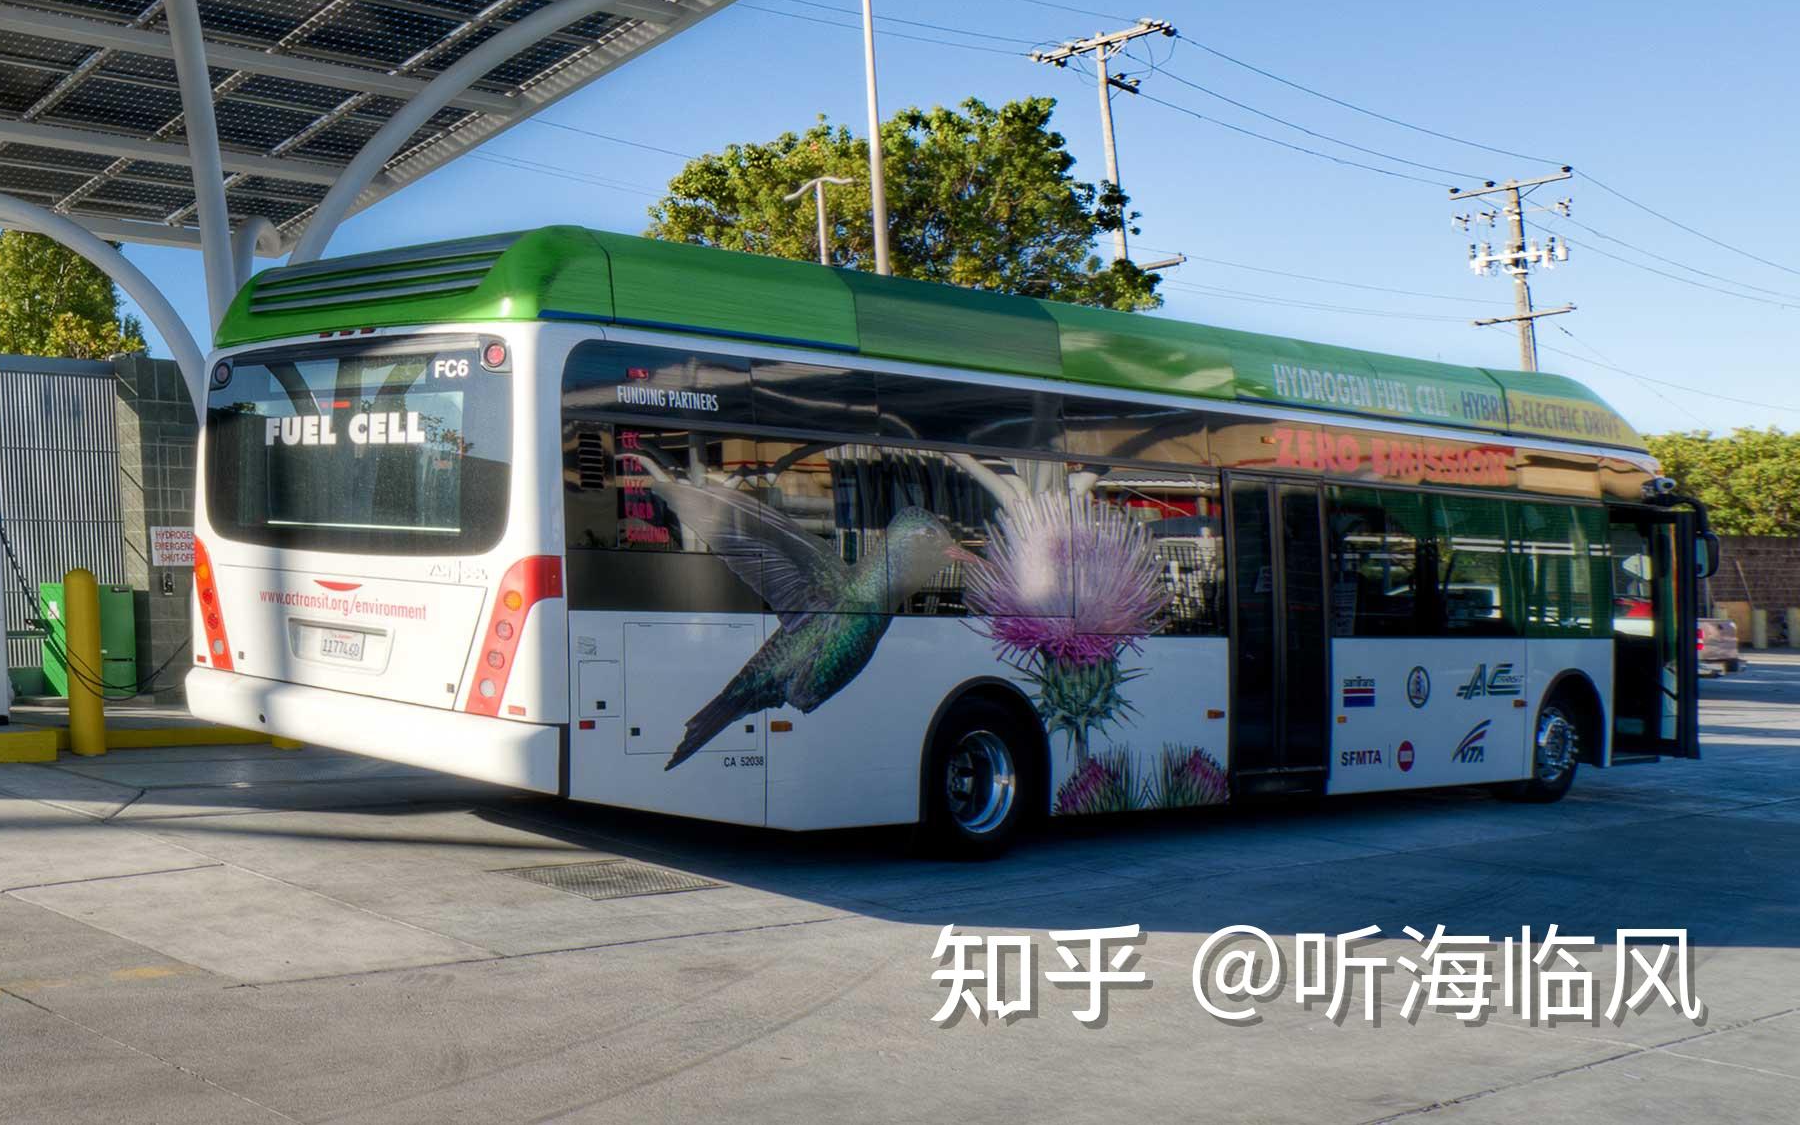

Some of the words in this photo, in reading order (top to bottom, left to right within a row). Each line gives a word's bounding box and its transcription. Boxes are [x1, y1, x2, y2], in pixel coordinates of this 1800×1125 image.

[434, 359, 469, 378] FC6
[616, 385, 666, 407] FUNDING
[668, 390, 719, 412] PARTNERS
[1272, 363, 1372, 407] HYDROGEN
[1374, 378, 1412, 413] FUEL
[1416, 385, 1449, 417] CELL
[1584, 410, 1622, 440] DRIVE
[265, 415, 336, 446] FUEL
[348, 411, 426, 445] CELL
[1273, 428, 1360, 472] ZERO
[1371, 438, 1509, 486] EMISSION
[155, 530, 193, 539] HYDROGE
[154, 542, 194, 551] EMERGENC
[259, 589, 427, 621] www.actransit.org/environment
[724, 757, 736, 767] CA
[1341, 750, 1382, 766] SFMTA
